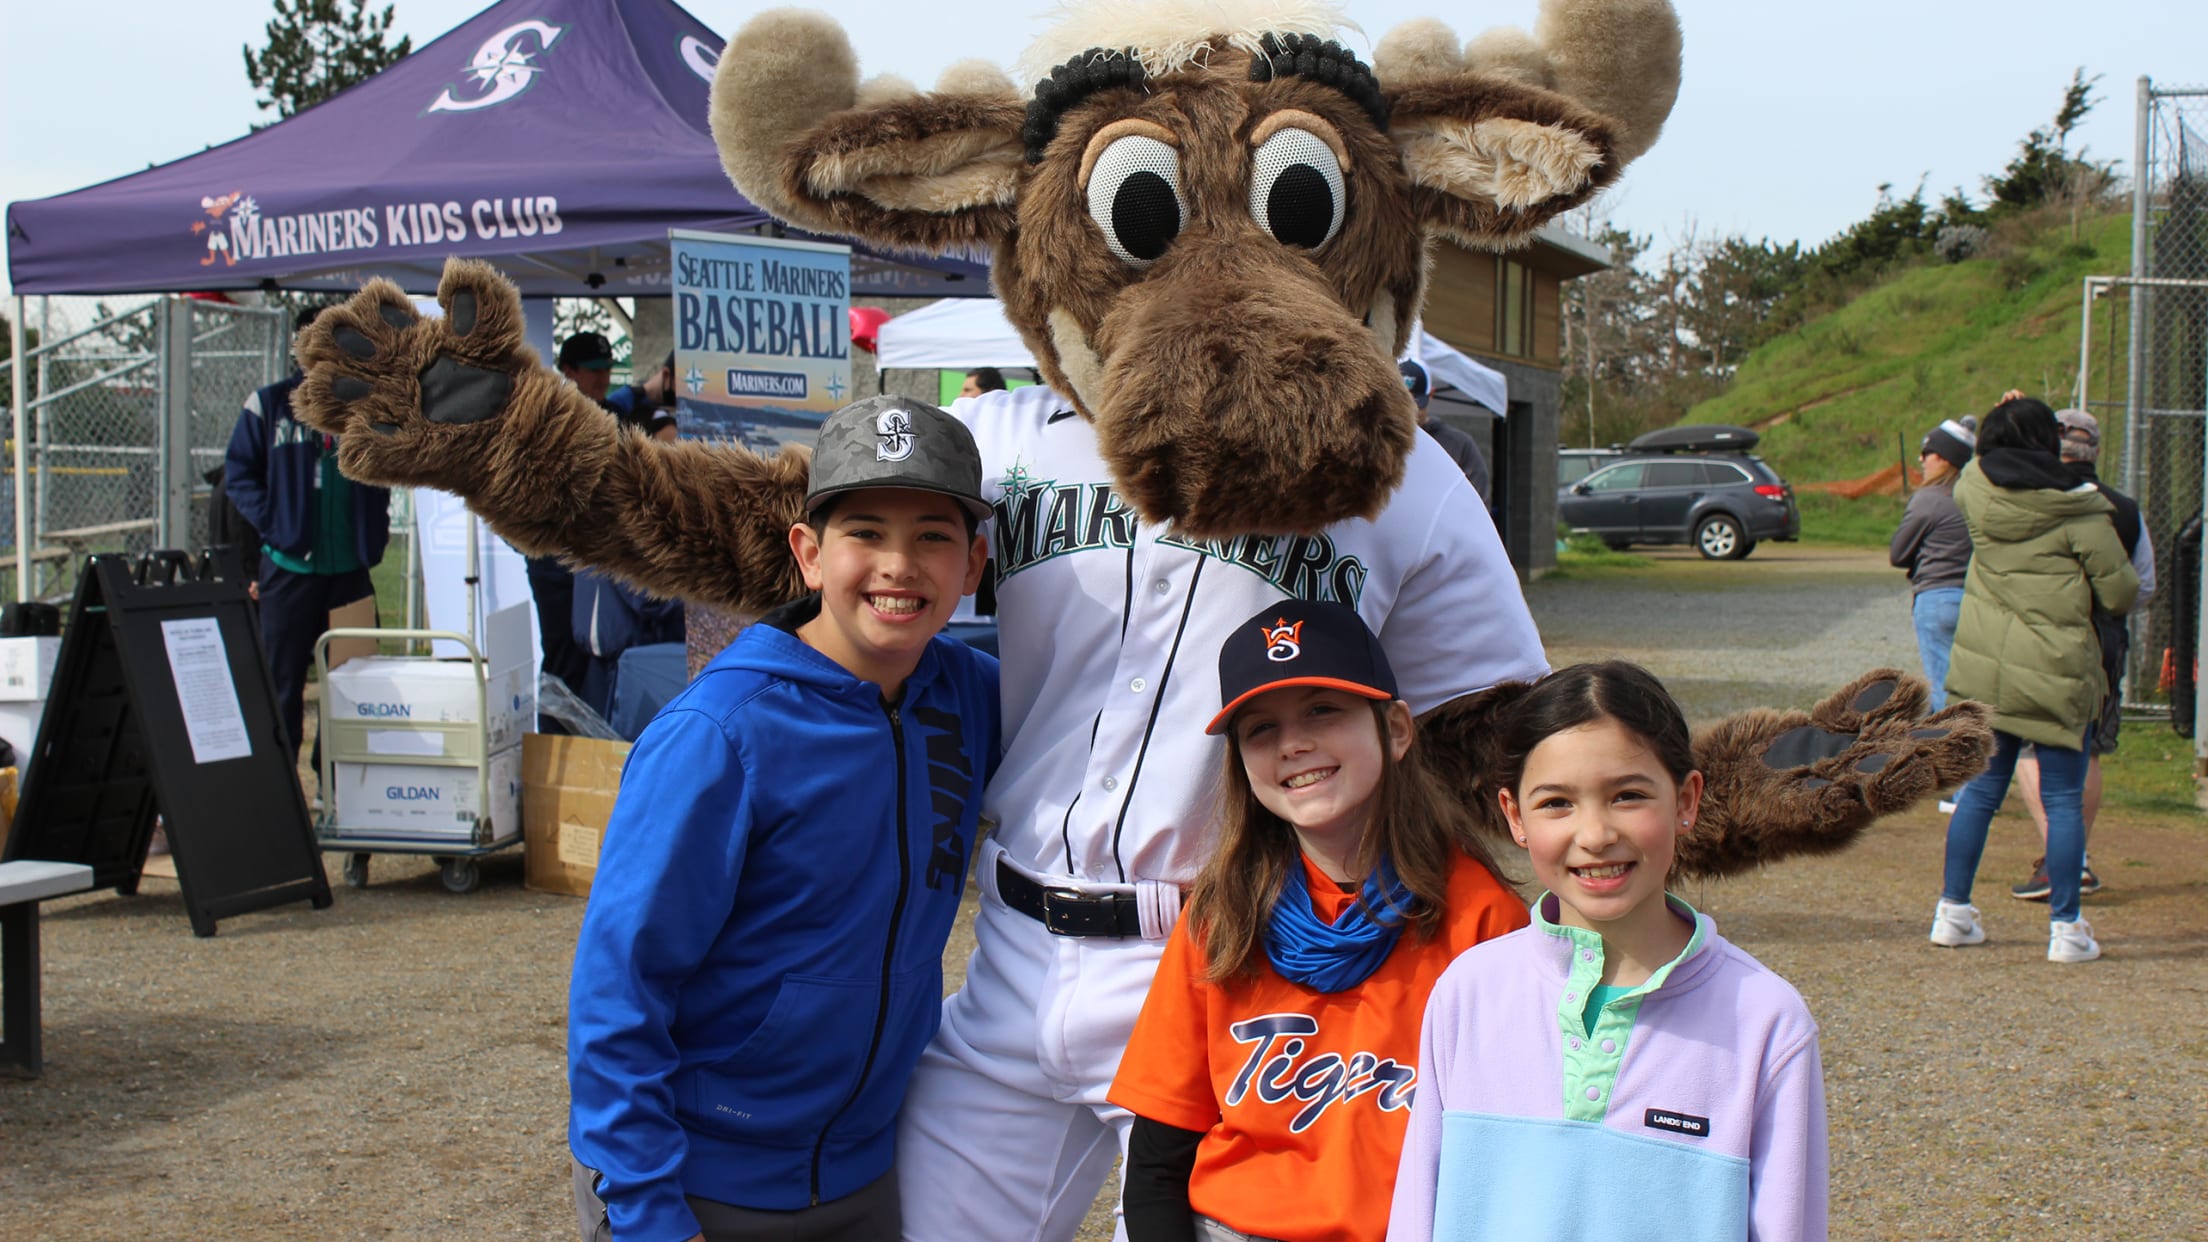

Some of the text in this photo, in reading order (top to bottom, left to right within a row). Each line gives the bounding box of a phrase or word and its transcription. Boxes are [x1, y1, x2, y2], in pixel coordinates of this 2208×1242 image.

[229, 195, 564, 261] MARINERS KIDS CLUB
[678, 251, 755, 292] SEATTLE
[760, 258, 846, 300] MARINERS
[678, 292, 848, 361] BASEBALL
[357, 702, 412, 718] GILDAN
[386, 786, 440, 801] GILDAN
[911, 705, 974, 897] NIKE
[1225, 1012, 1417, 1134] Tiger
[716, 1103, 753, 1120] DRI-FIT
[1682, 1120, 1702, 1131] END
